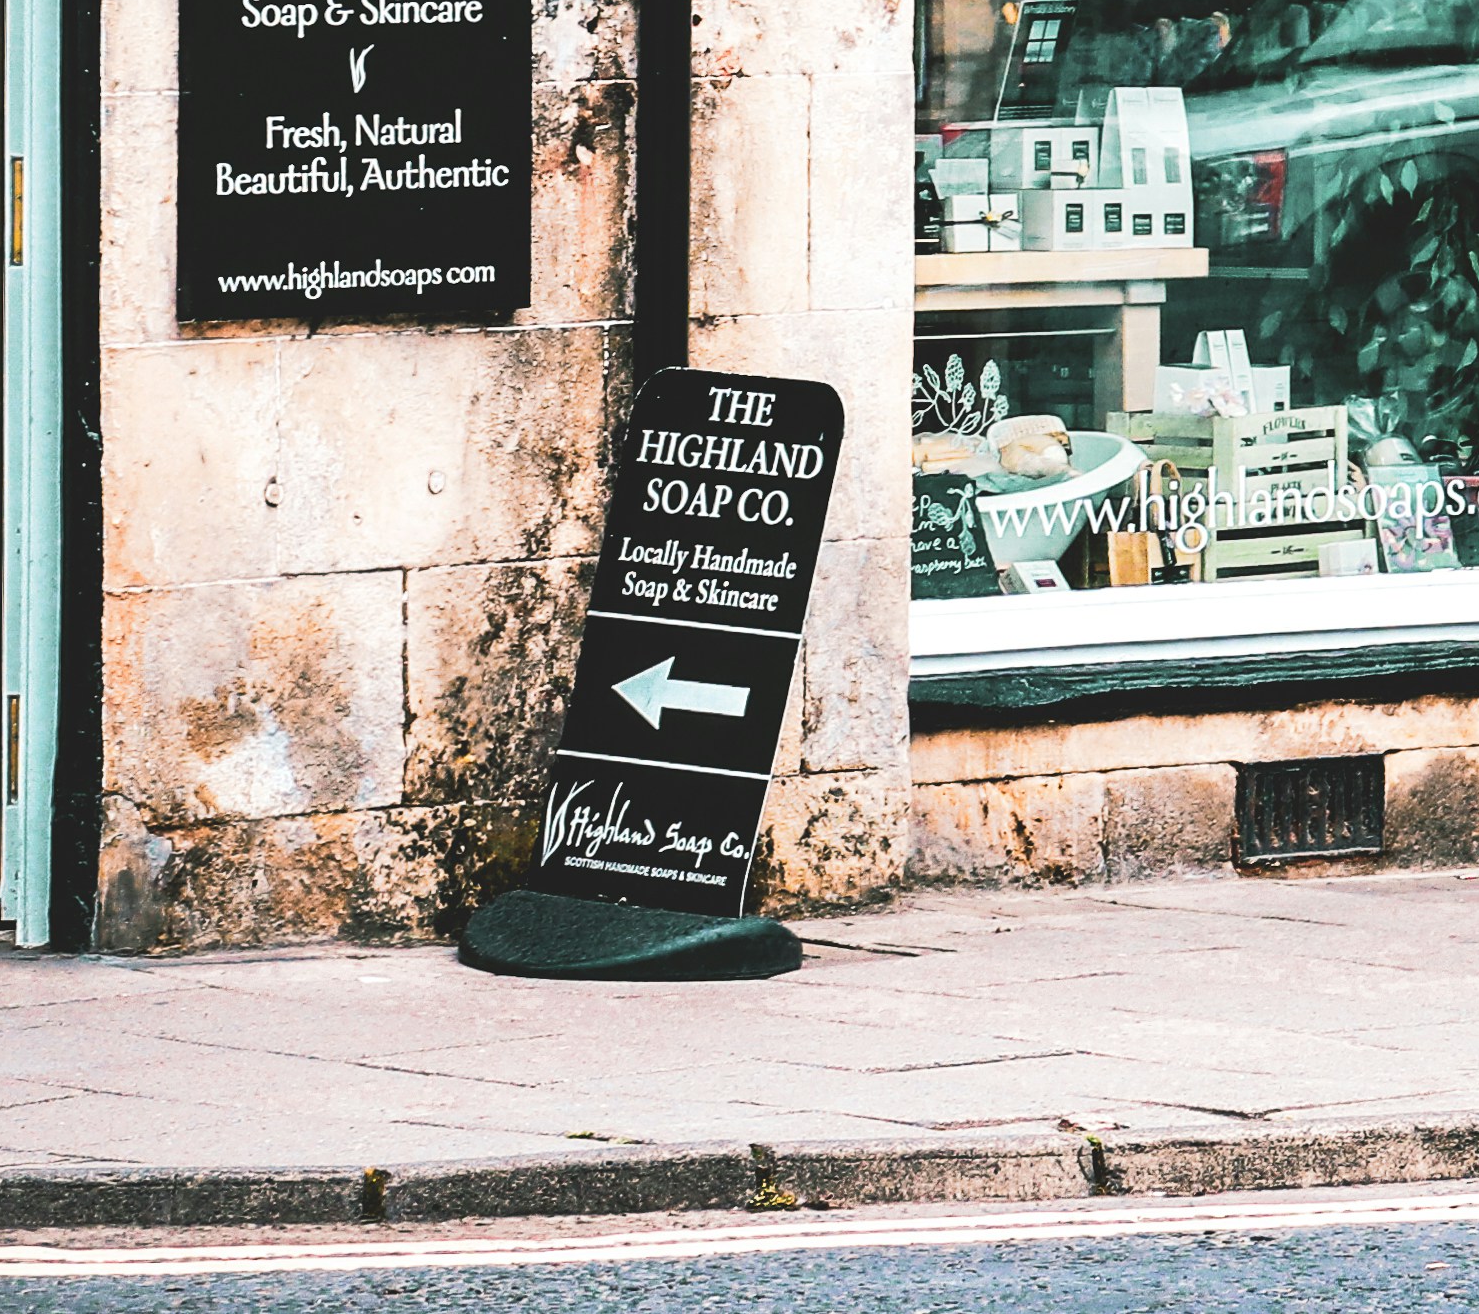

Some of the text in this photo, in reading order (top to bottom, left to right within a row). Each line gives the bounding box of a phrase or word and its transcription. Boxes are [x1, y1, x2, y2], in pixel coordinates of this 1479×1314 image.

[266, 109, 461, 153] Fresh, Natural
[216, 154, 509, 197] Beautiful, Authentic
[709, 387, 775, 426] THE
[636, 429, 824, 480] HIGHLAND
[643, 478, 793, 526] SOAP CO.
[618, 537, 797, 579] Locally Handmade
[622, 571, 779, 612] Soap & Skincare
[568, 782, 751, 868] Highland Soap Co.
[564, 856, 605, 872] SCOTTISH
[605, 861, 651, 877] HANDMADE
[651, 868, 678, 880] SOAPS
[685, 873, 728, 887] SKINCARE
